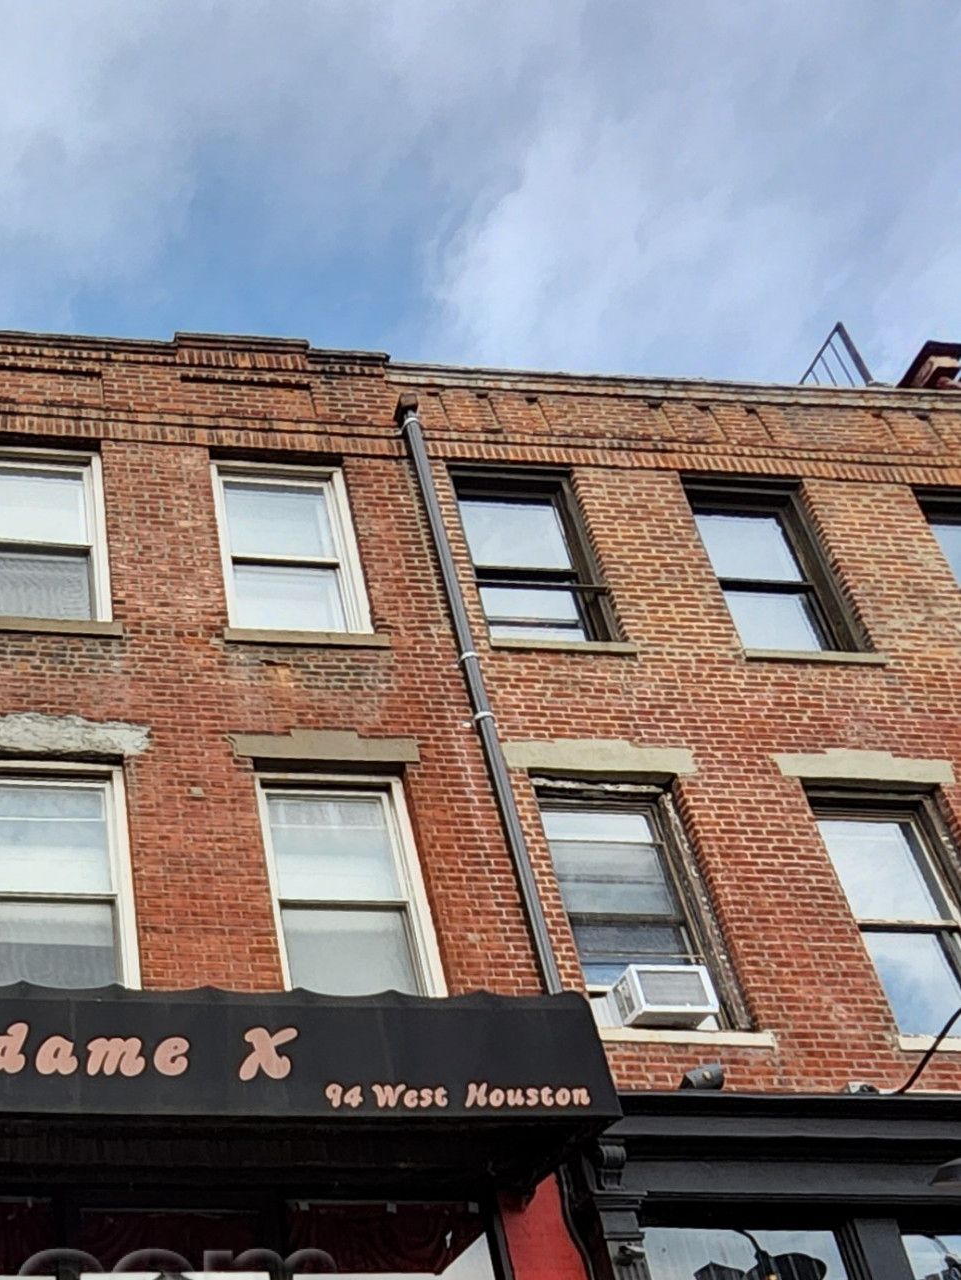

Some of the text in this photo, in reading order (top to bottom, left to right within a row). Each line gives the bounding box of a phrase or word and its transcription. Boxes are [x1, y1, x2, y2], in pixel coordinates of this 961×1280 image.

[237, 1026, 299, 1081] X
[324, 1082, 592, 1109] 94 West Houston
